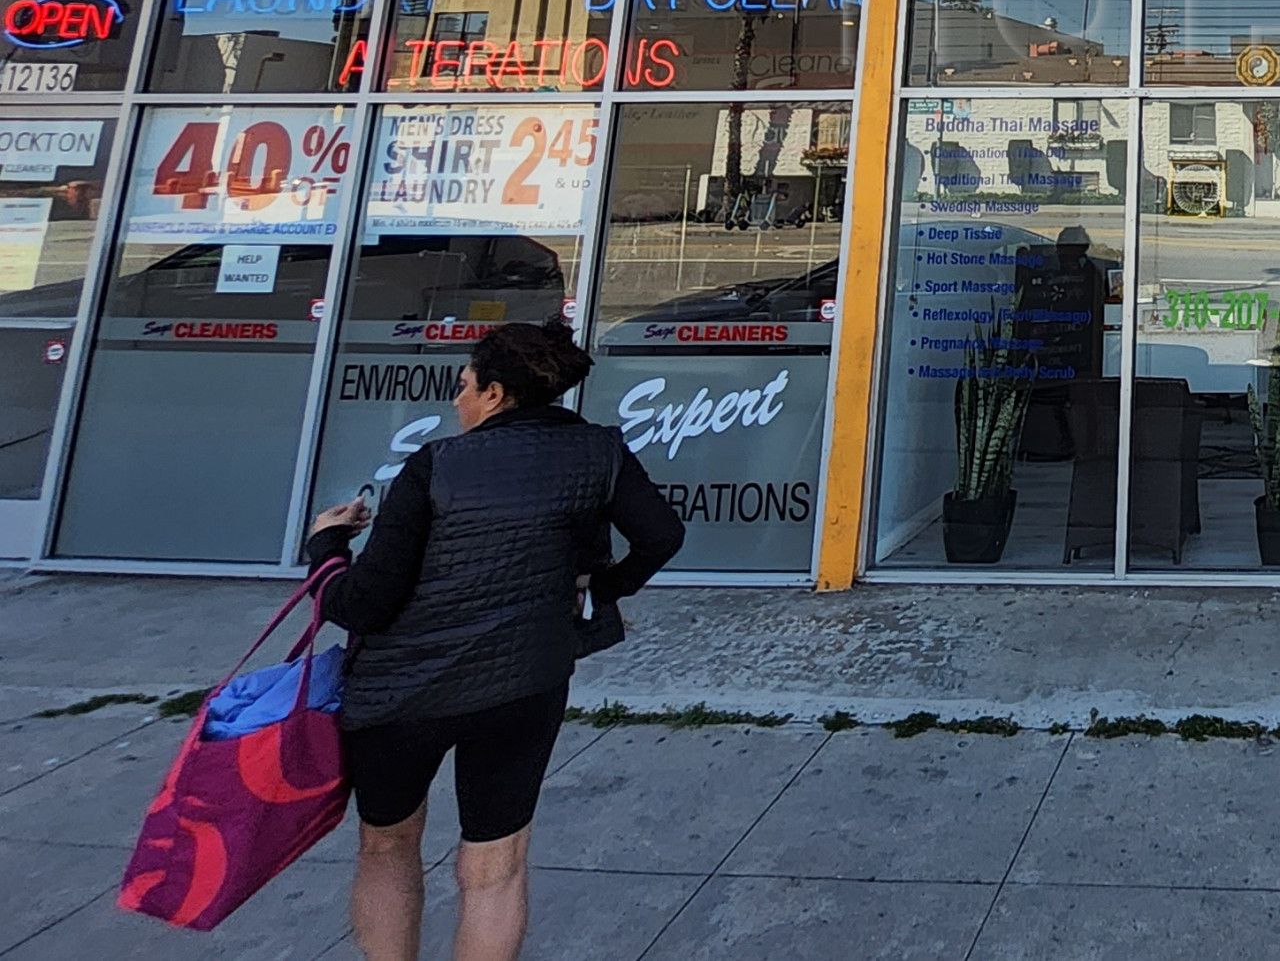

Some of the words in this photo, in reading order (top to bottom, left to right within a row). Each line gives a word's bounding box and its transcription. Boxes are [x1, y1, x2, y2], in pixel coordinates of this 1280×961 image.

[338, 38, 680, 88] ATERATIONS
[7, 65, 75, 92] 12136
[390, 115, 445, 137] MEN'S
[450, 115, 505, 136] DRESS
[925, 117, 985, 133] Buddha
[990, 117, 1024, 133] Thai
[1028, 117, 1099, 135] Massage
[383, 139, 501, 175] SHIRT
[570, 179, 592, 191] up
[934, 173, 995, 186] Traditional
[1028, 173, 1083, 188] Massage
[379, 178, 496, 205] LAUNDRY
[930, 201, 981, 214] Swedish
[985, 201, 1040, 216] Massage
[272, 222, 323, 235] ACCOUNT
[928, 227, 959, 242] Deep
[236, 254, 264, 265] HELP
[927, 252, 948, 265] Hot
[951, 252, 985, 265] Stone
[989, 252, 1046, 269] Massage
[223, 273, 270, 284] WANTED
[925, 280, 958, 295] Sport
[961, 280, 1017, 296] Massage
[922, 308, 994, 324] Reflexology
[174, 322, 279, 340] CLEANERS
[676, 324, 789, 342] CLEANERS
[918, 365, 975, 380] Massage
[1039, 365, 1076, 381] Scrub
[618, 368, 790, 461] Expert
